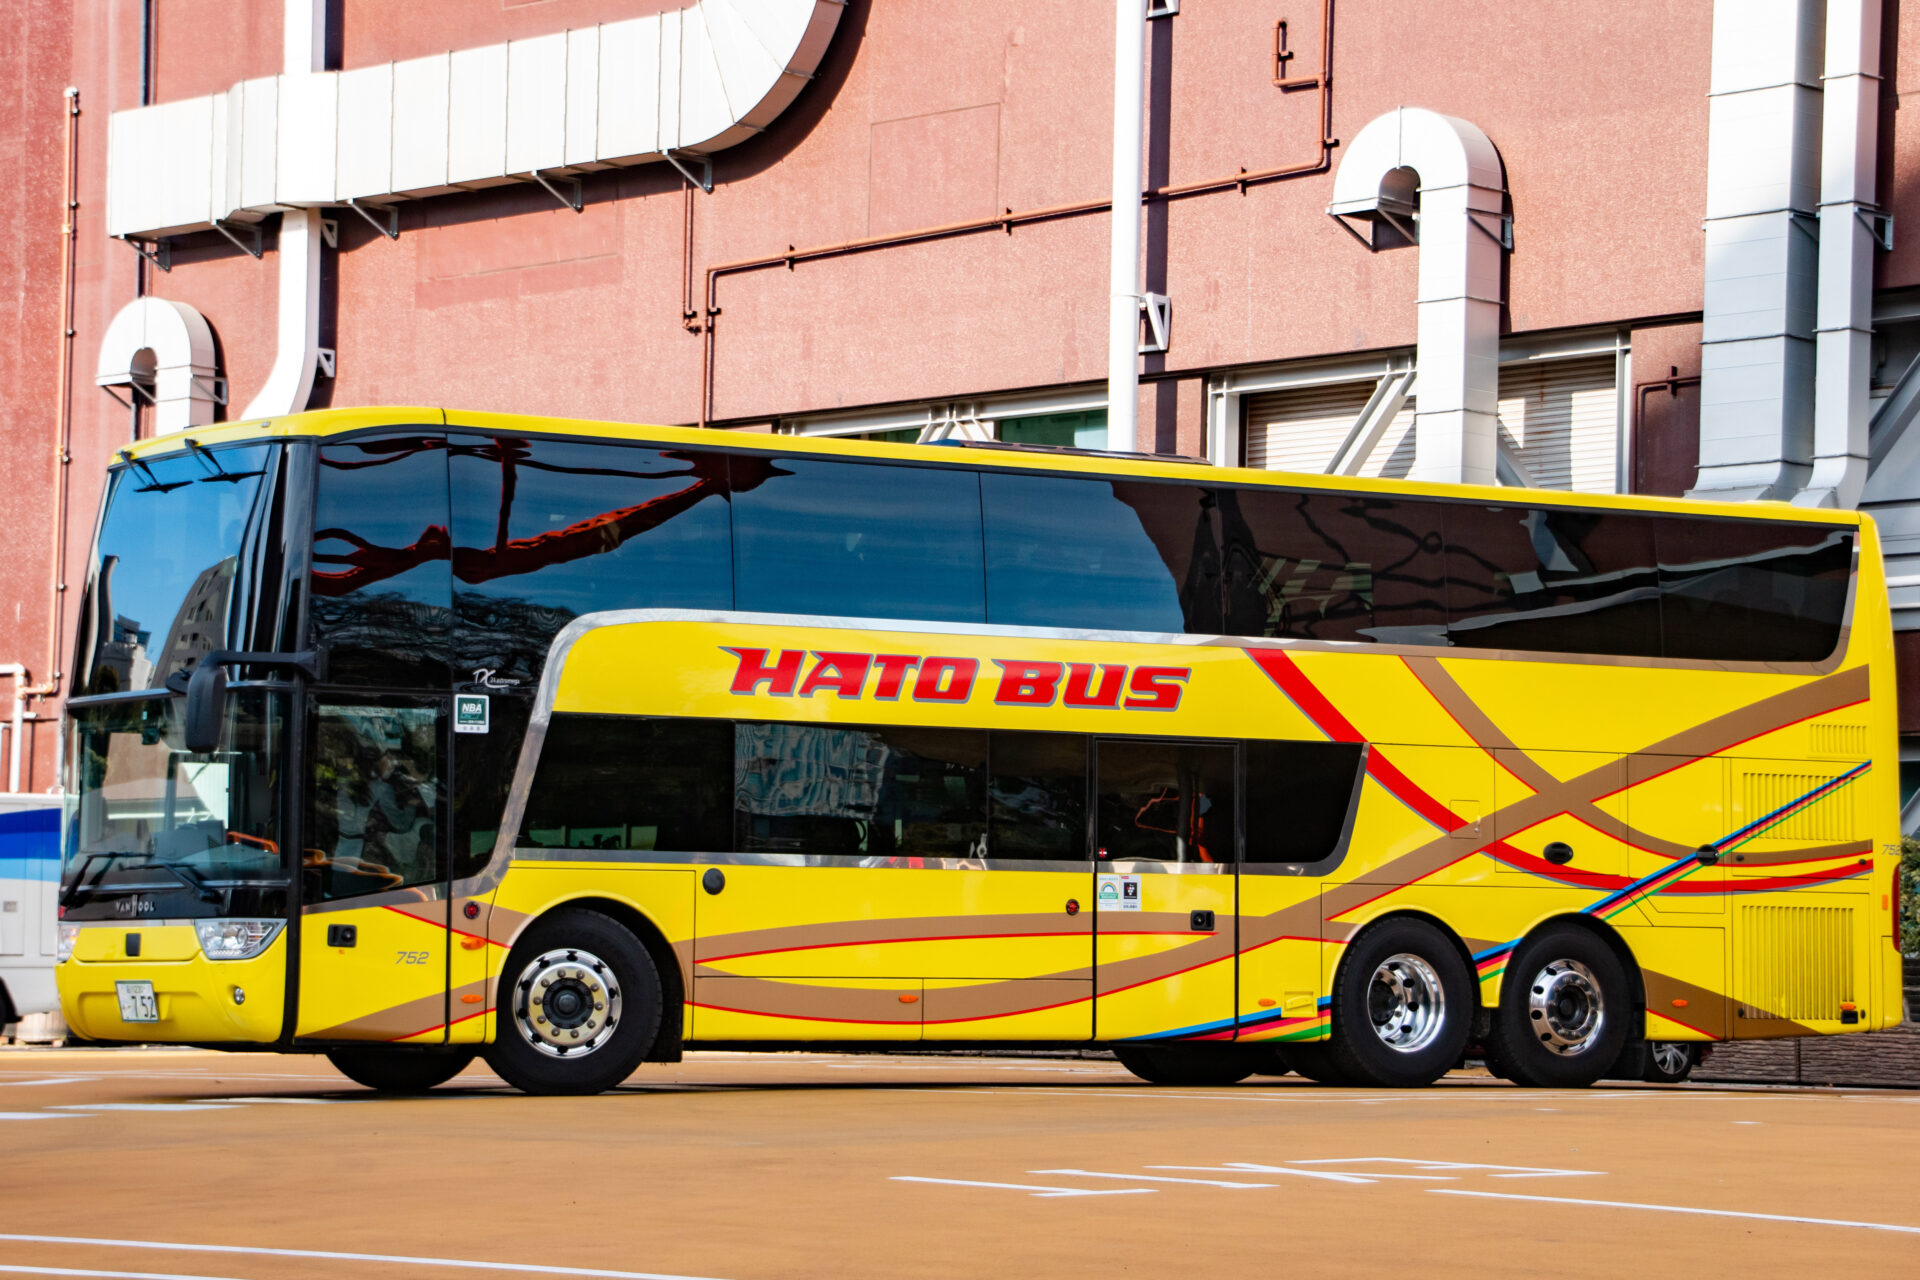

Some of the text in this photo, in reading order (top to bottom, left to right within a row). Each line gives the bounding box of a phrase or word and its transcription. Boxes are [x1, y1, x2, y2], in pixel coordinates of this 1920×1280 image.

[717, 646, 1192, 713] HATO BUS
[462, 703, 482, 713] NBA
[395, 951, 430, 965] 752
[131, 995, 156, 1018] 752
